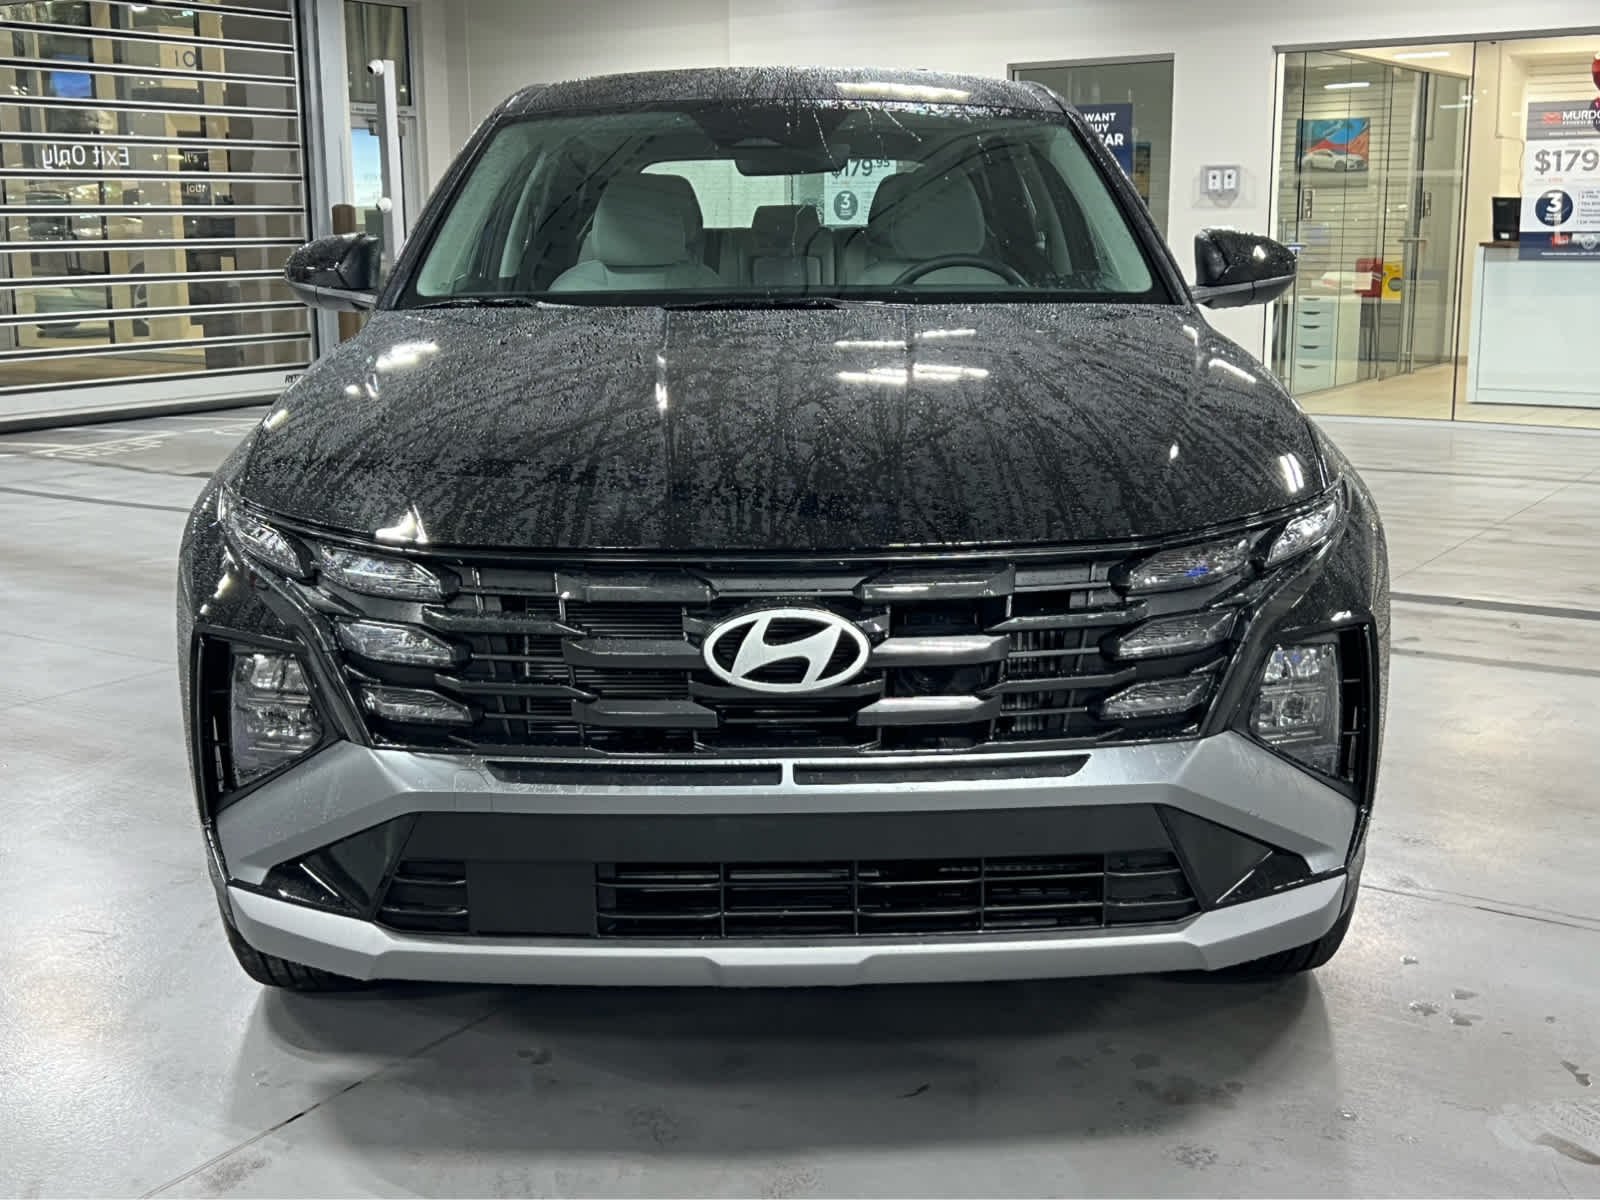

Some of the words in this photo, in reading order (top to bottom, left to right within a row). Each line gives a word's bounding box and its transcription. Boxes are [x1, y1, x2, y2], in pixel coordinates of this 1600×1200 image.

[1084, 112, 1117, 122] WANT
[1534, 149, 1600, 175] $179
[840, 193, 850, 209] 3
[1546, 192, 1562, 213] 3
